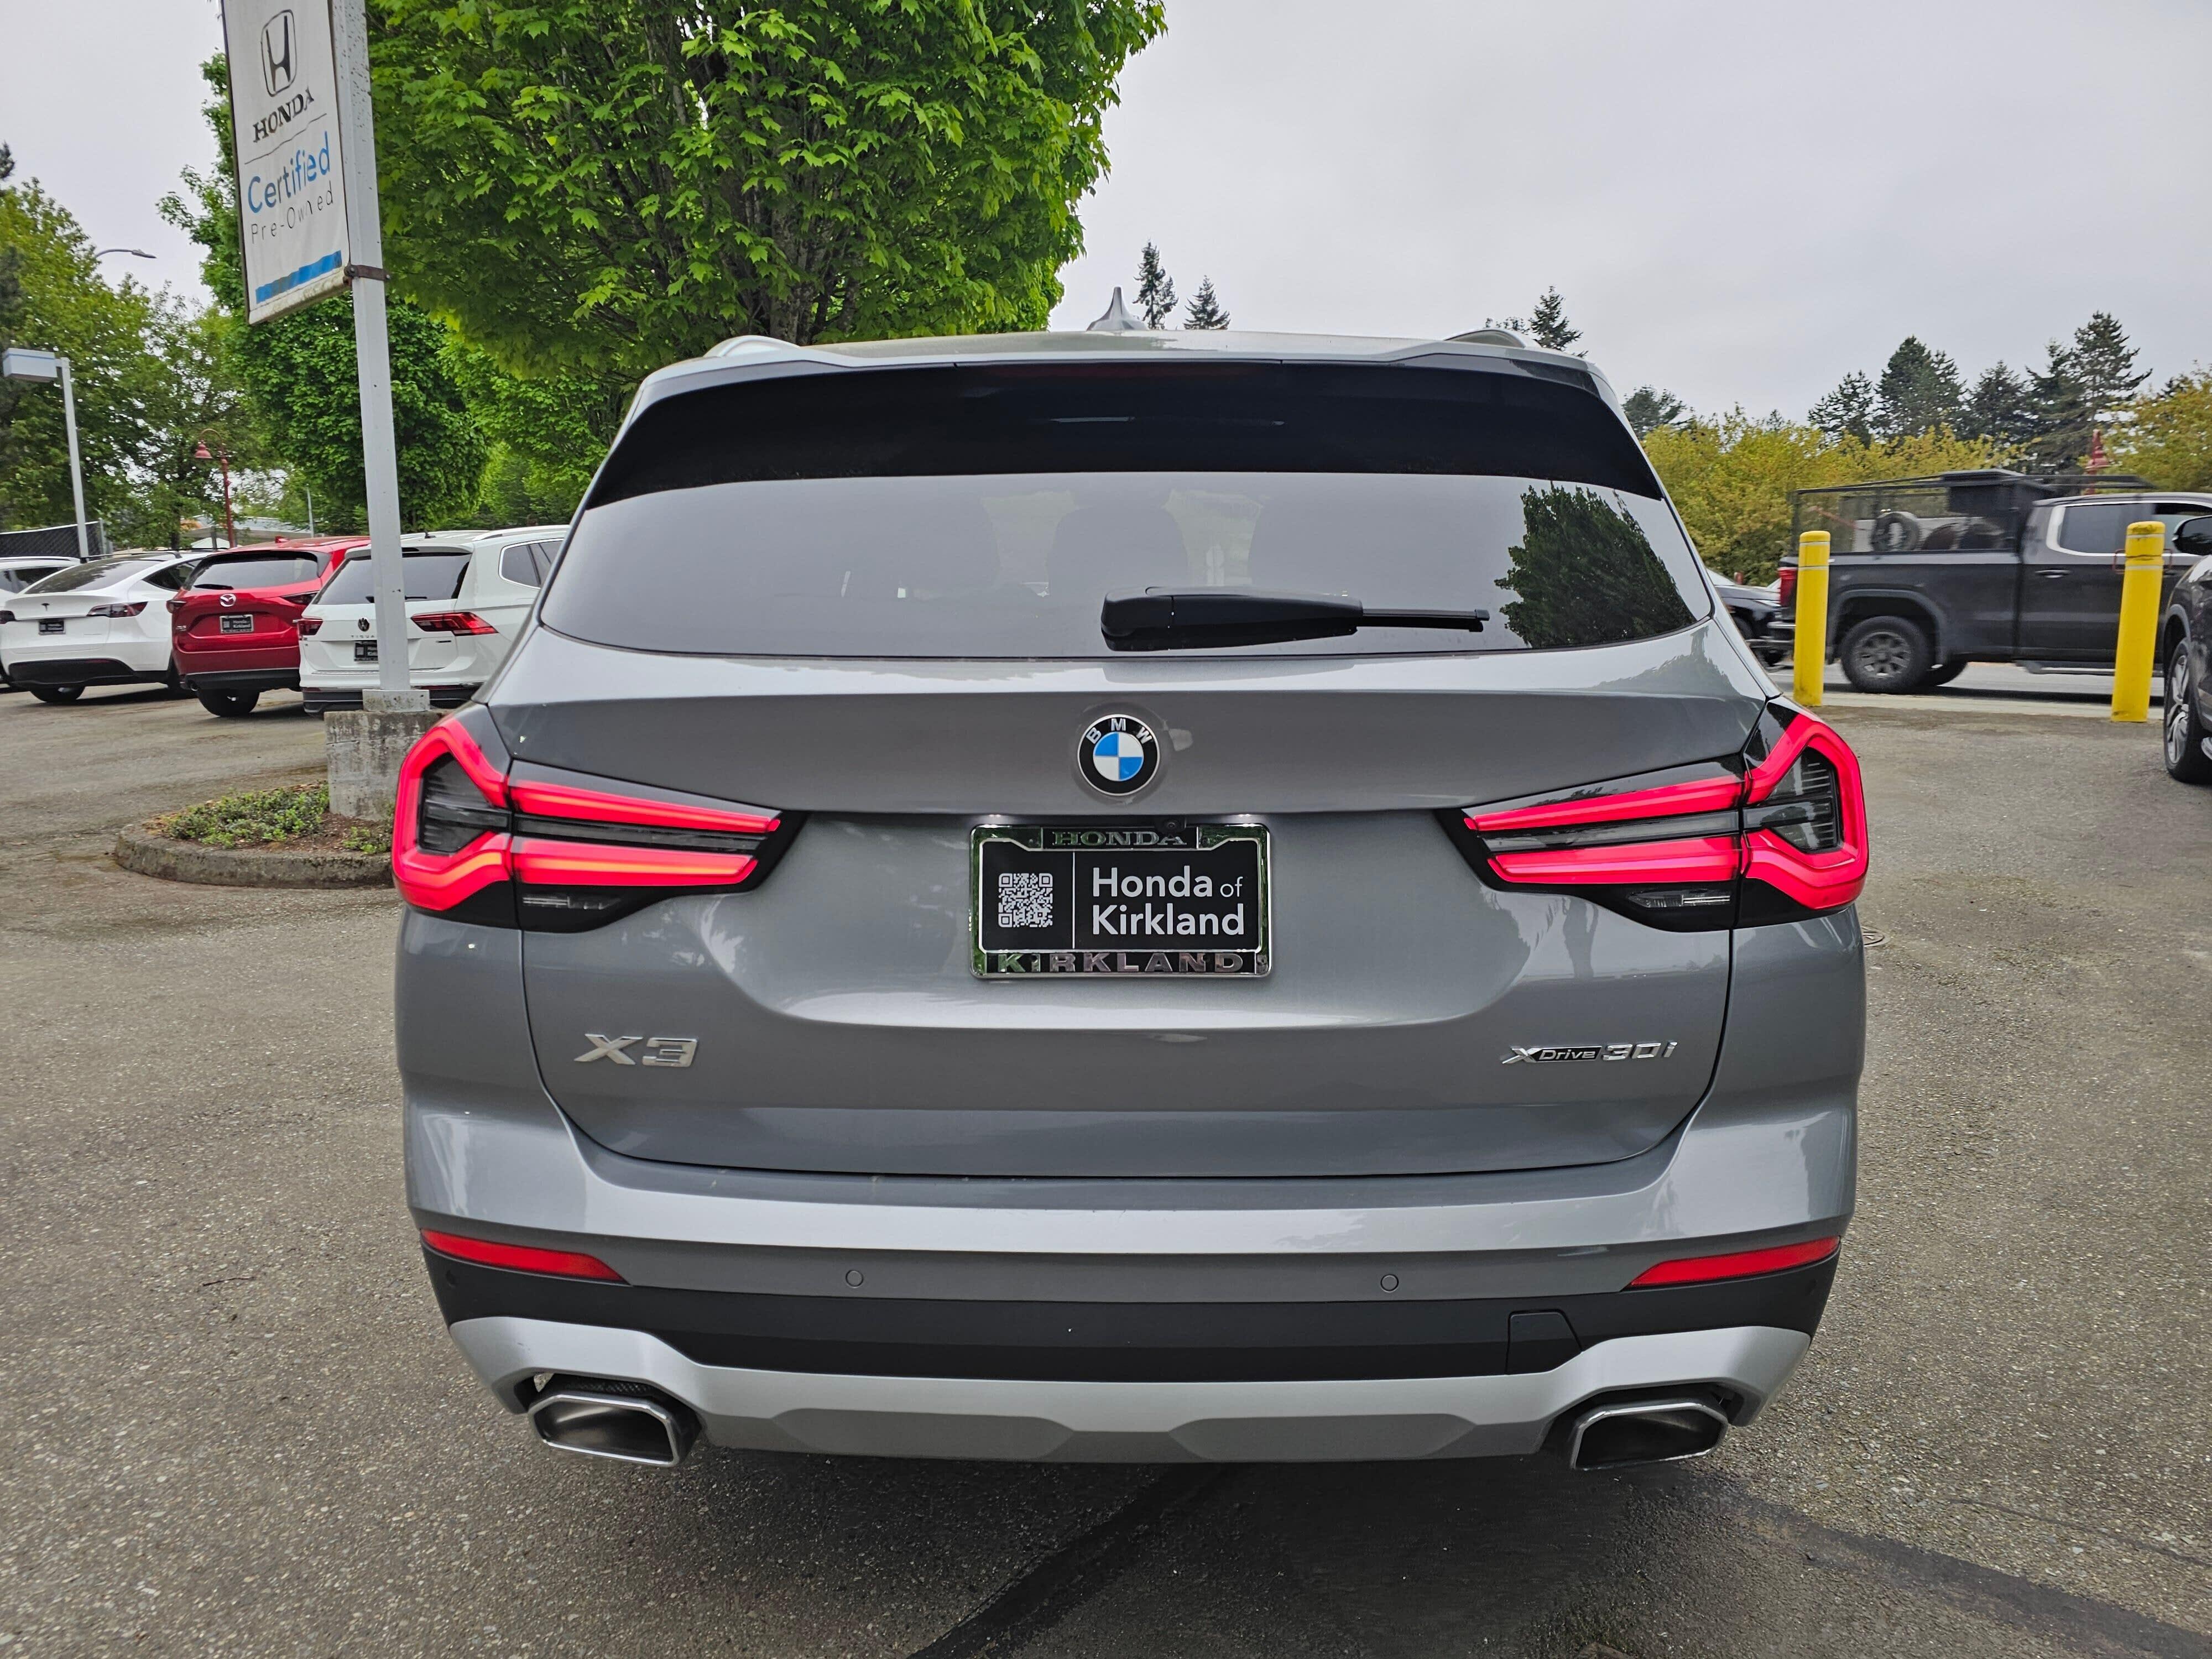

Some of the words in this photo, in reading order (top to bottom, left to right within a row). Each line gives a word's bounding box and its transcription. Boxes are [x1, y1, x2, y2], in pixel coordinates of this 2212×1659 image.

[253, 87, 315, 143] HONDA
[248, 131, 330, 213] Certified
[251, 180, 333, 244] Pre-Owned
[1086, 718, 1153, 744] BMW
[1052, 831, 1187, 846] HONDA
[1093, 865, 1213, 898] Honda
[1220, 877, 1244, 898] of
[1093, 903, 1244, 935] Kirkland
[998, 952, 1244, 973] KIRKLAND
[573, 1033, 698, 1067] X3
